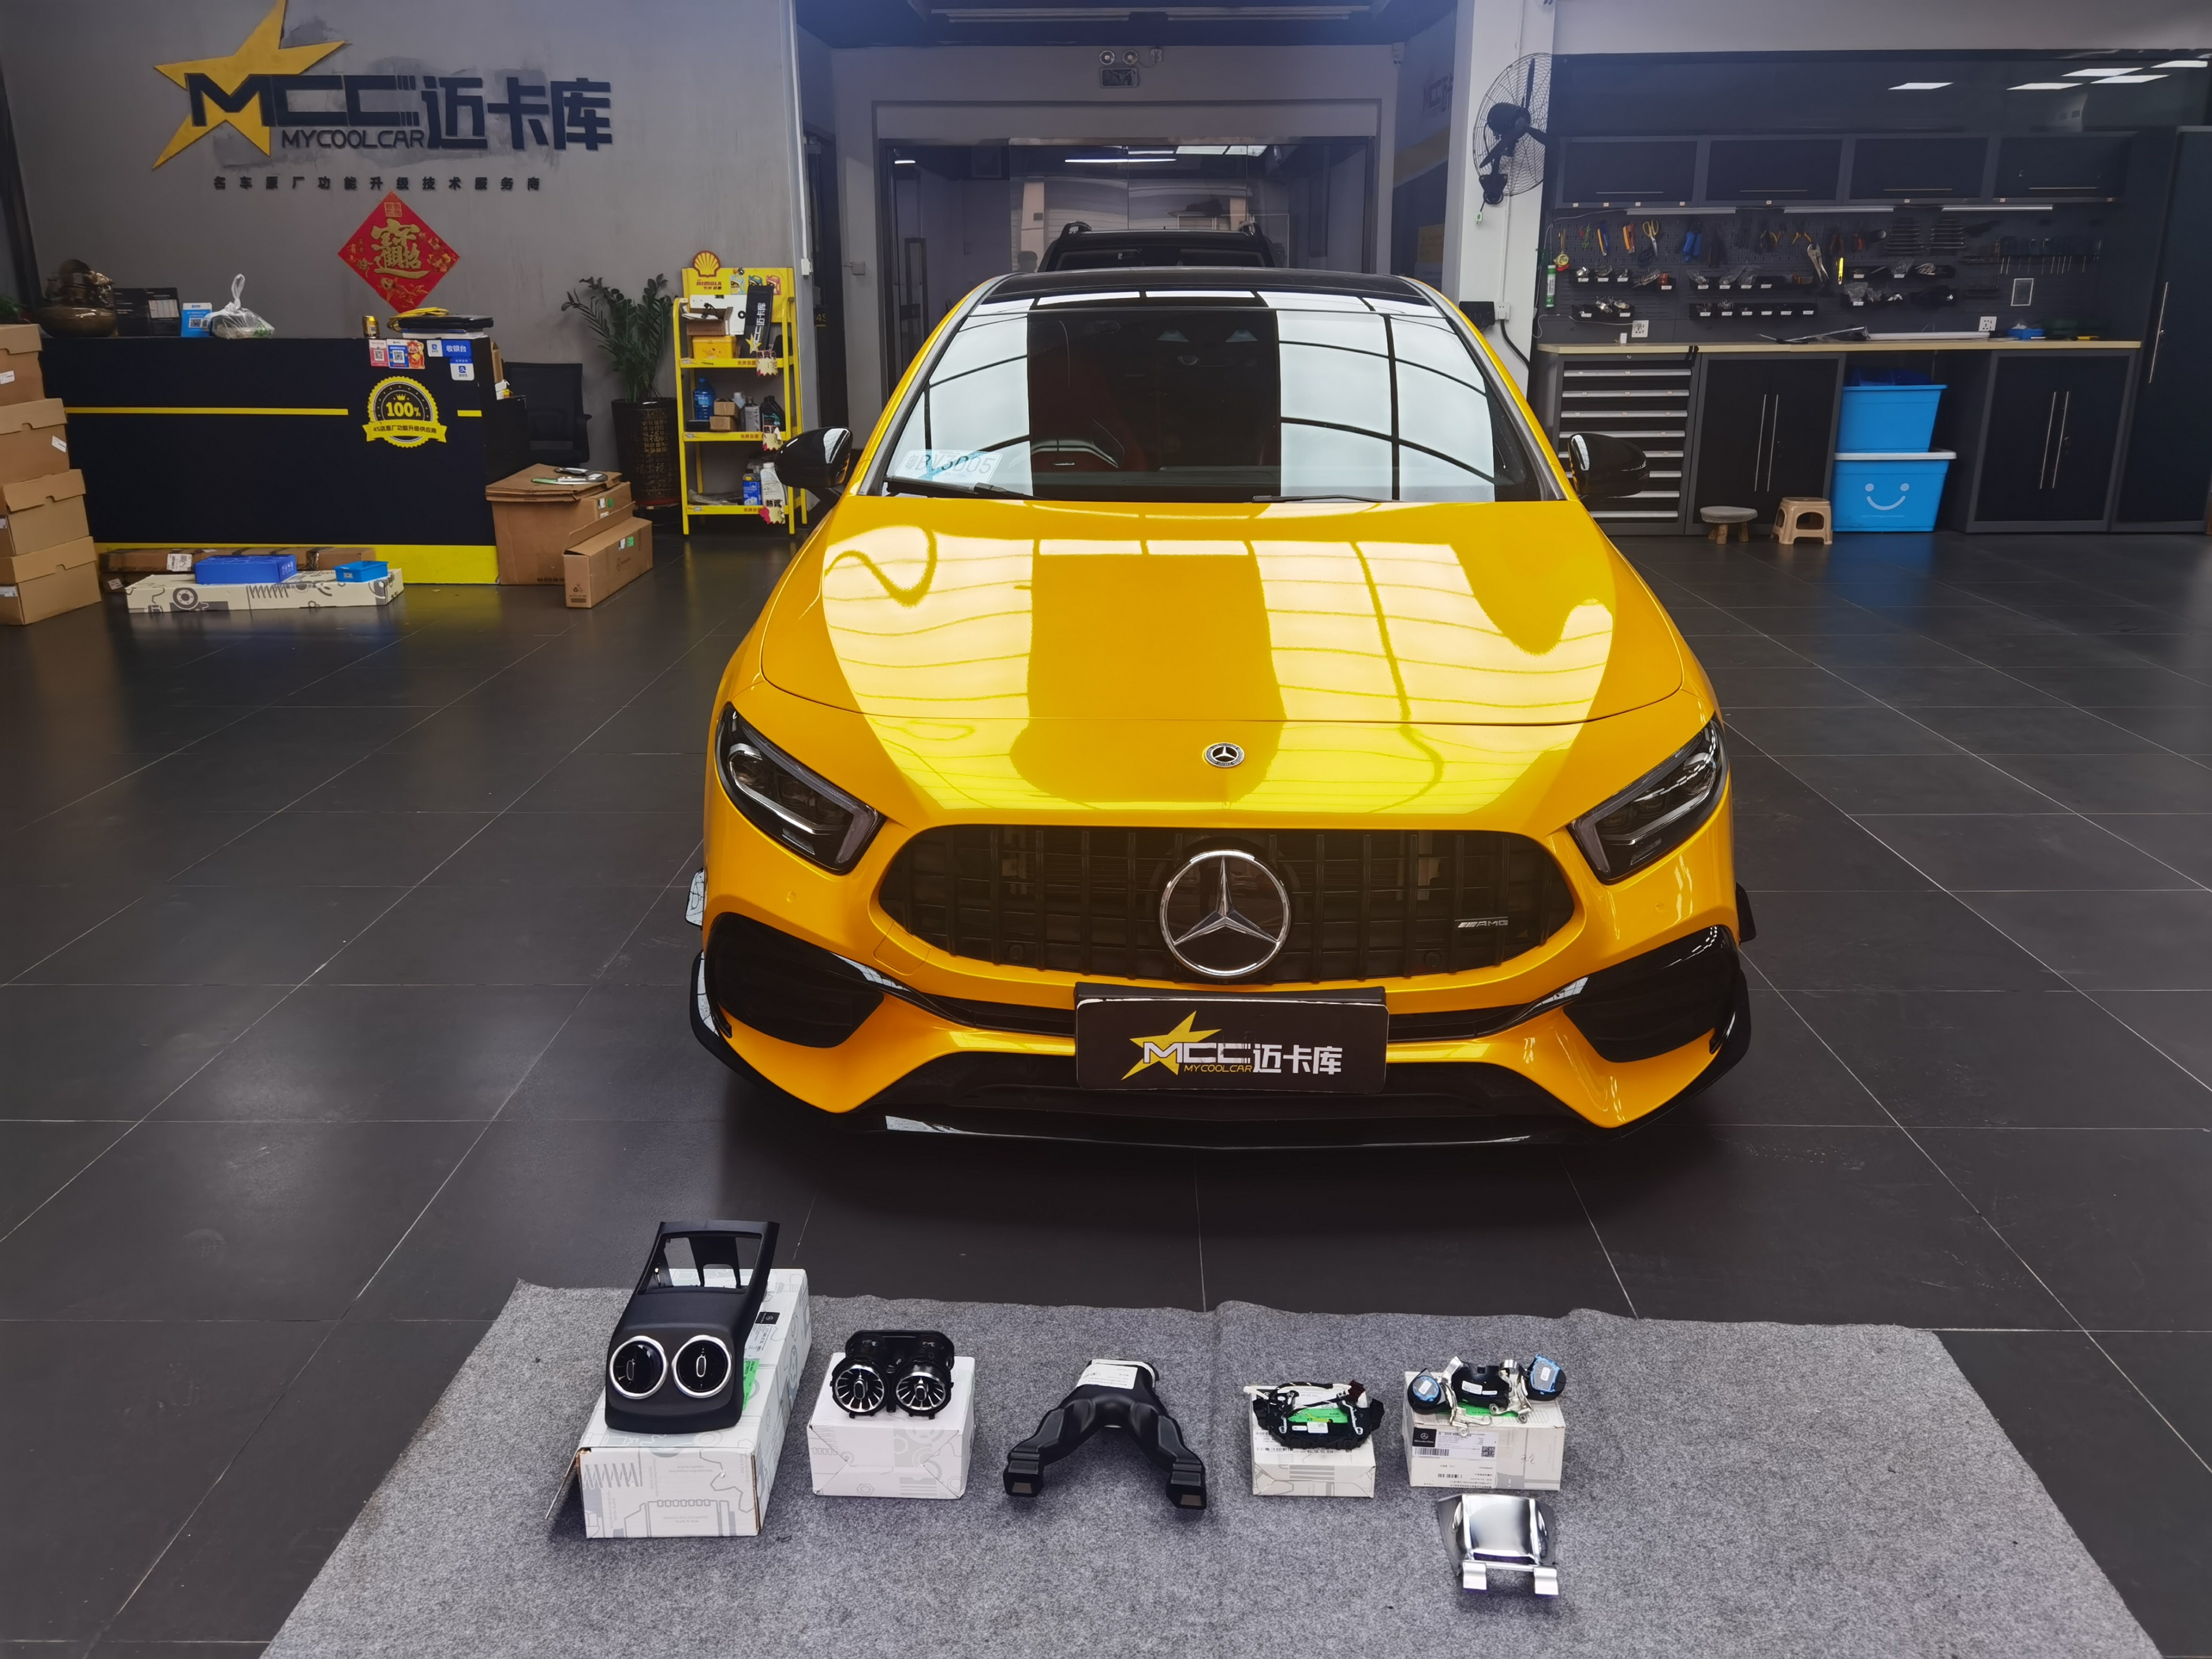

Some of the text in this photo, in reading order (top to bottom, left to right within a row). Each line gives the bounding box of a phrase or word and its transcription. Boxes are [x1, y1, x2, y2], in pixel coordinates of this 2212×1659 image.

[421, 76, 612, 151] 迈卡库
[282, 130, 425, 149] MYCOOLCAR
[213, 176, 541, 191] 名车原厂功能升级技术服务商
[386, 402, 421, 417] 100%
[1252, 1043, 1343, 1075] 迈卡库
[1184, 1064, 1252, 1073] MYCOOLCAR
